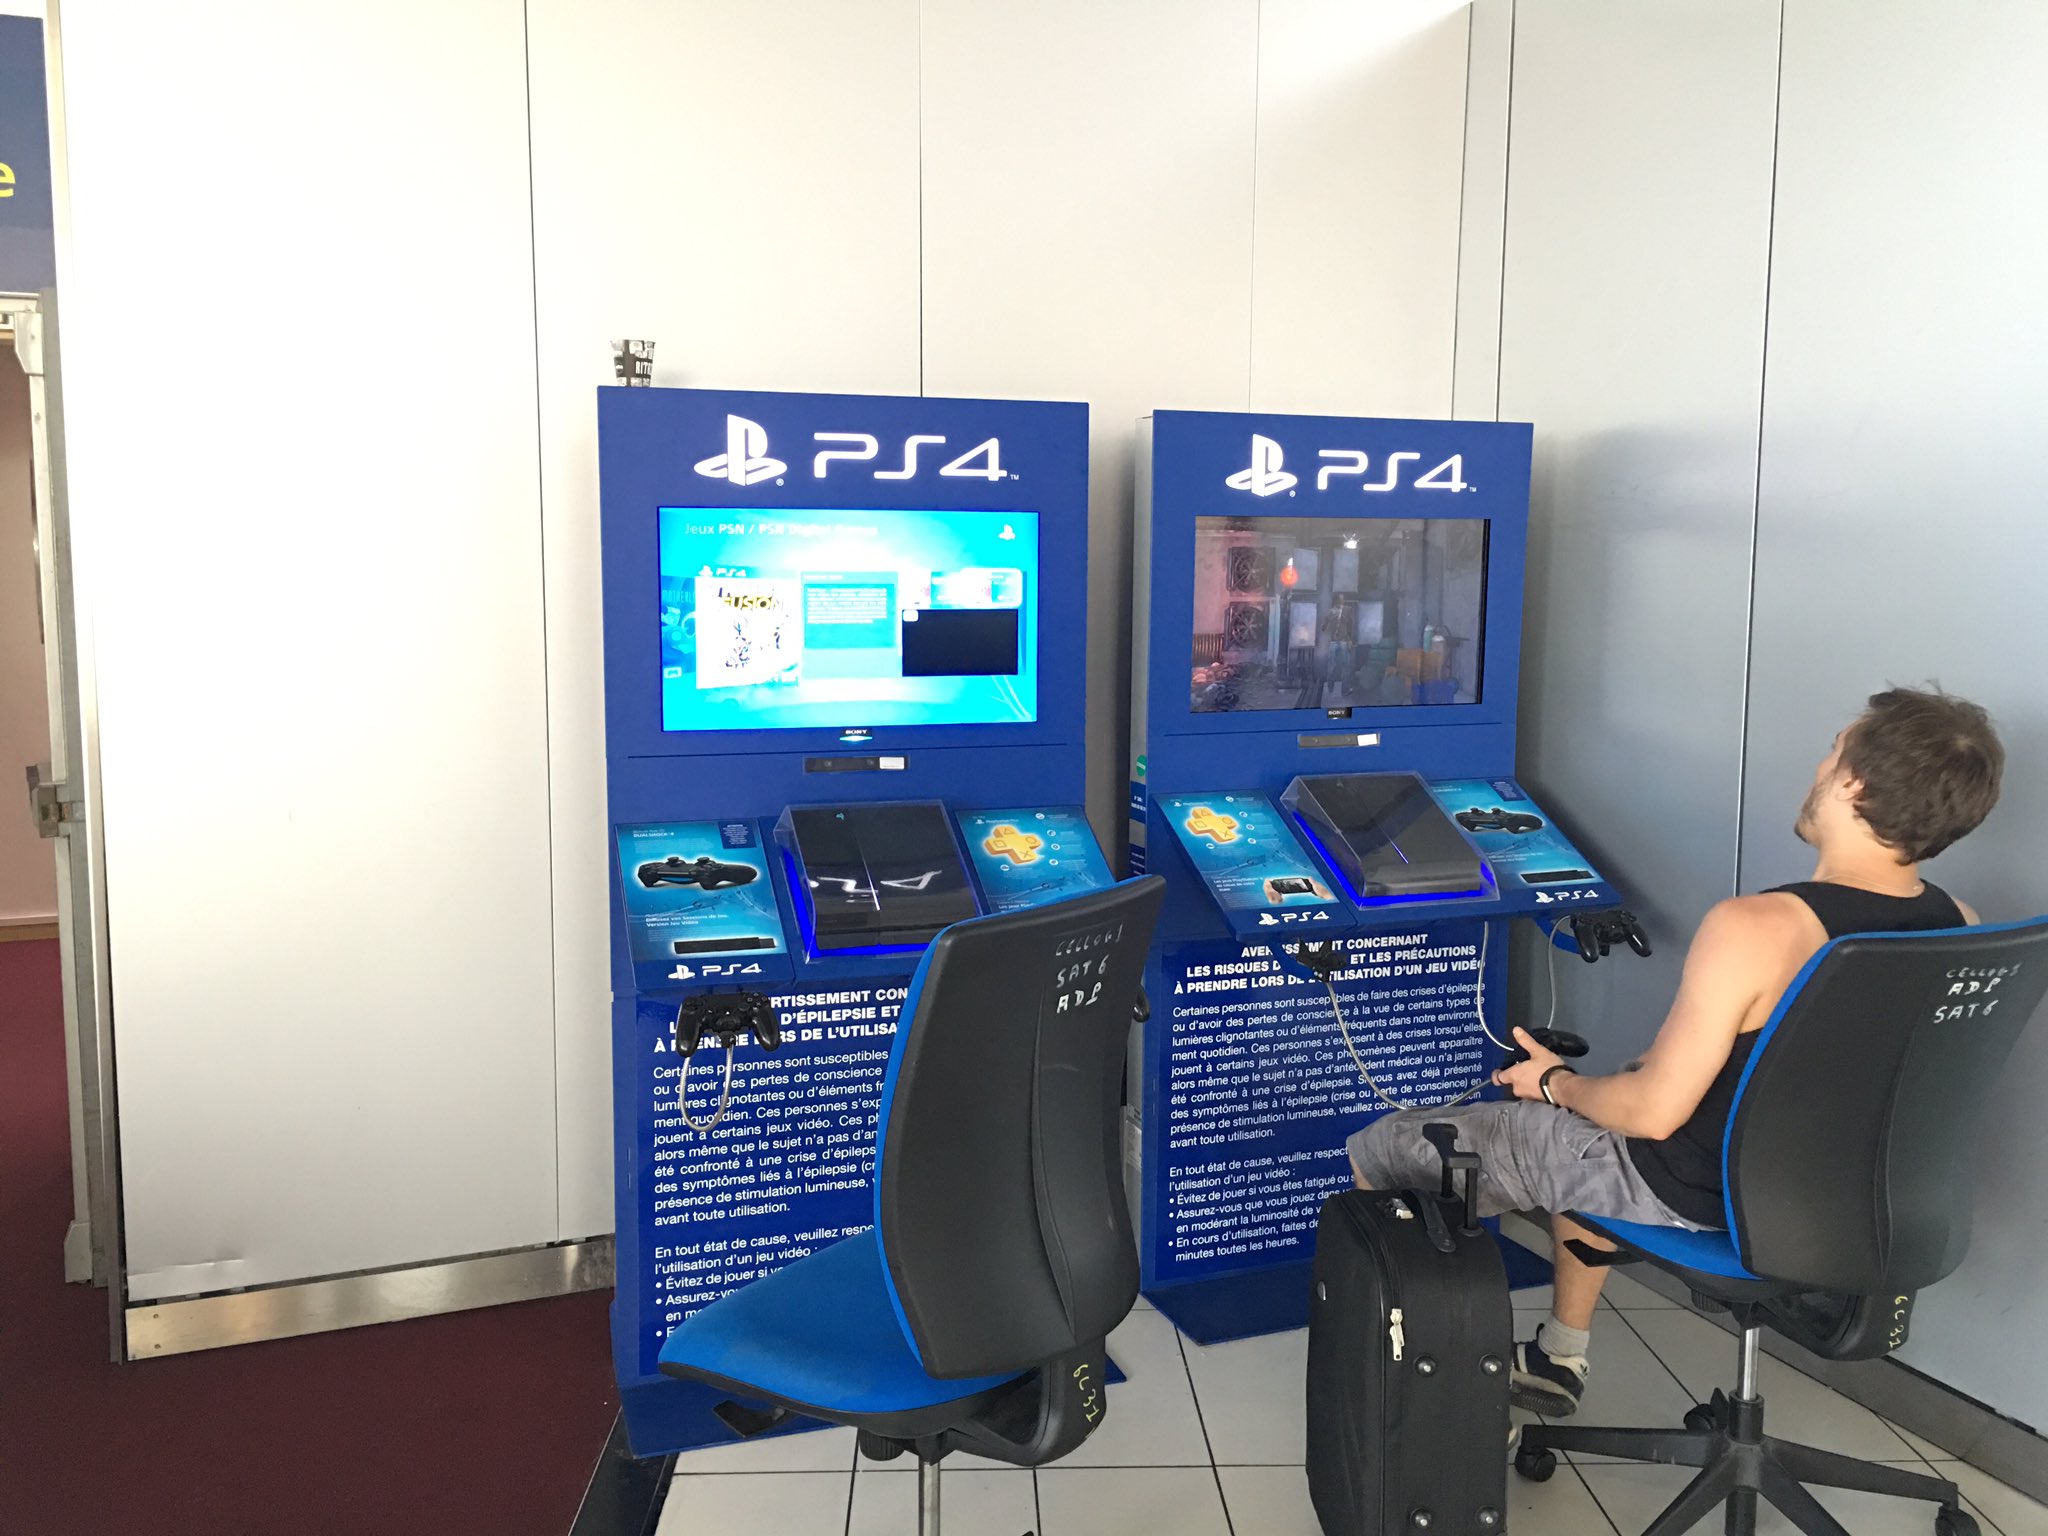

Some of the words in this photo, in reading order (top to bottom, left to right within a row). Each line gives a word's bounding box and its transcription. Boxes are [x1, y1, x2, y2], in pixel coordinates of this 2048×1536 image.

[813, 432, 1007, 481] PS4
[1317, 449, 1467, 492] PS4
[684, 524, 714, 536] Jeux
[718, 524, 745, 535] PSN
[1554, 889, 1599, 901] PS4
[1281, 911, 1330, 923] PS4
[1346, 933, 1427, 949] CONCERNANT
[702, 963, 762, 977] PS4
[1186, 965, 1210, 977] LES
[1214, 960, 1269, 975] RISQUES
[1350, 953, 1365, 964] ET
[1369, 951, 1391, 963] LES
[1394, 945, 1476, 961] PRÉCAUTIONS
[1174, 980, 1183, 994] À
[1187, 978, 1247, 993] PRENDRE
[1251, 974, 1284, 988] LORS
[1394, 964, 1422, 976] D'UN
[1425, 962, 1447, 973] JEU
[768, 990, 870, 1008] RTISSEMENT
[875, 987, 908, 1001] CON
[1172, 1005, 1219, 1017] Certaines
[1221, 1001, 1272, 1015] personnes
[1273, 998, 1295, 1008] sont
[1356, 991, 1368, 1001] de
[1370, 990, 1390, 999] faire
[1391, 988, 1408, 998] des
[1409, 987, 1436, 996] crises
[780, 1006, 876, 1025] D'ÉPILEPSIE
[881, 1005, 900, 1017] ET
[1172, 1023, 1185, 1032] ou
[1188, 1020, 1222, 1030] d'avoir
[1225, 1017, 1243, 1027] des
[1247, 1014, 1277, 1027] pertes
[1280, 1011, 1293, 1022] de
[1352, 1005, 1358, 1015] à
[1362, 1005, 1370, 1014] la
[1373, 1004, 1389, 1013] vue
[1392, 1002, 1404, 1012] de
[1407, 1000, 1443, 1010] certains
[1446, 997, 1470, 1009] types
[654, 1037, 665, 1053] À
[800, 1028, 822, 1041] DE
[827, 1022, 897, 1039] L'UTILISA
[716, 1059, 781, 1077] prsonnes
[784, 1055, 810, 1068] sont
[813, 1049, 888, 1065] susceptibles
[653, 1085, 669, 1095] ou
[750, 1074, 789, 1089] pertes
[793, 1071, 809, 1083] de
[814, 1067, 882, 1081] conscience
[788, 1090, 803, 1099] ou
[806, 1082, 872, 1097] d'éléments
[875, 1080, 884, 1091] fr
[654, 1112, 683, 1128] ment
[756, 1106, 780, 1118] Ces
[784, 1101, 847, 1118] personnes
[851, 1098, 881, 1110] s'exp
[654, 1130, 693, 1147] jouent
[711, 1125, 761, 1139] certains
[766, 1122, 791, 1136] jeux
[797, 1117, 833, 1130] vidéo.
[838, 1114, 862, 1126] Ces
[867, 1112, 879, 1126] ph
[654, 1149, 685, 1161] alors
[688, 1144, 728, 1157] même
[731, 1142, 755, 1155] que
[758, 1139, 769, 1150] le
[772, 1136, 801, 1150] sujet
[805, 1134, 823, 1145] n'a
[827, 1133, 849, 1146] pas
[852, 1129, 877, 1141] d'an
[654, 1164, 674, 1177] été
[680, 1157, 740, 1174] confronté
[745, 1156, 753, 1167] à
[759, 1155, 782, 1166] une
[787, 1151, 816, 1163] crise
[822, 1146, 876, 1160] d'épileps
[654, 1182, 677, 1193] des
[682, 1174, 755, 1192] symptômes
[760, 1170, 780, 1182] liés
[784, 1168, 792, 1179] à
[797, 1162, 857, 1179] l'épilepsie
[861, 1160, 875, 1173] (cr
[654, 1195, 712, 1212] présence
[715, 1191, 732, 1203] de
[734, 1184, 801, 1201] stimulation
[804, 1178, 869, 1193] lumineuse,
[654, 1212, 689, 1226] avant
[692, 1209, 725, 1221] toute
[728, 1202, 790, 1217] utilisation.
[655, 1246, 671, 1258] En
[675, 1243, 699, 1256] tout
[703, 1240, 727, 1253] état
[730, 1237, 746, 1249] de
[750, 1234, 790, 1247] cause,
[794, 1227, 838, 1241] veuillez
[1175, 1249, 1214, 1261] minutes
[1216, 1244, 1247, 1256] toutes
[1249, 1241, 1263, 1251] les
[1265, 1236, 1299, 1248] heures.
[655, 1258, 721, 1275] l'utilisation
[724, 1254, 752, 1266] d'un
[755, 1251, 774, 1265] jeu
[777, 1246, 810, 1259] vidéo
[665, 1275, 702, 1289] Évitez
[705, 1273, 722, 1284] de
[724, 1270, 754, 1285] jouer
[757, 1266, 767, 1278] si
[665, 1311, 681, 1322] en
